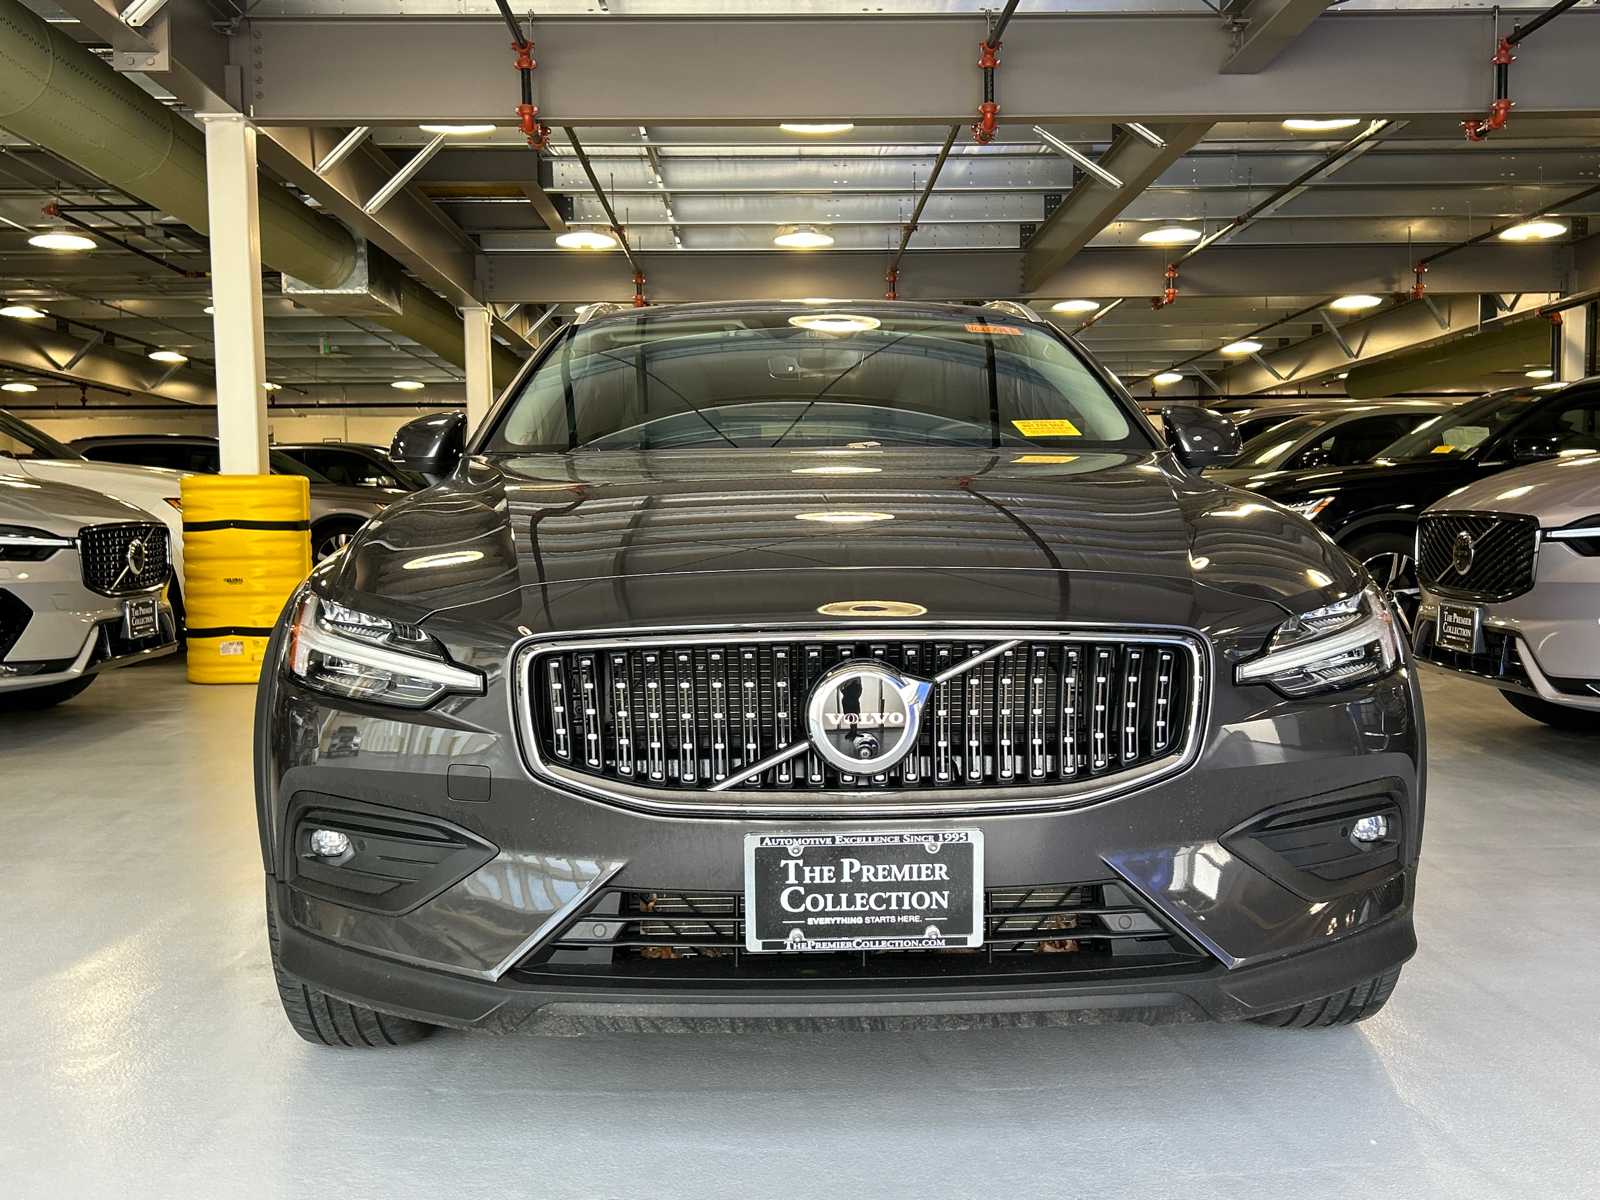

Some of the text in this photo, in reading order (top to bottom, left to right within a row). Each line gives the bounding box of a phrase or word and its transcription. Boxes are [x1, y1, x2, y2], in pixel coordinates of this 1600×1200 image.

[825, 712, 904, 725] VOLVO
[937, 832, 968, 842] 1995
[780, 858, 950, 885] THE PREMIER
[780, 886, 950, 913] COLLECTION
[807, 914, 923, 926] EVERYTHING STARTS HERE.
